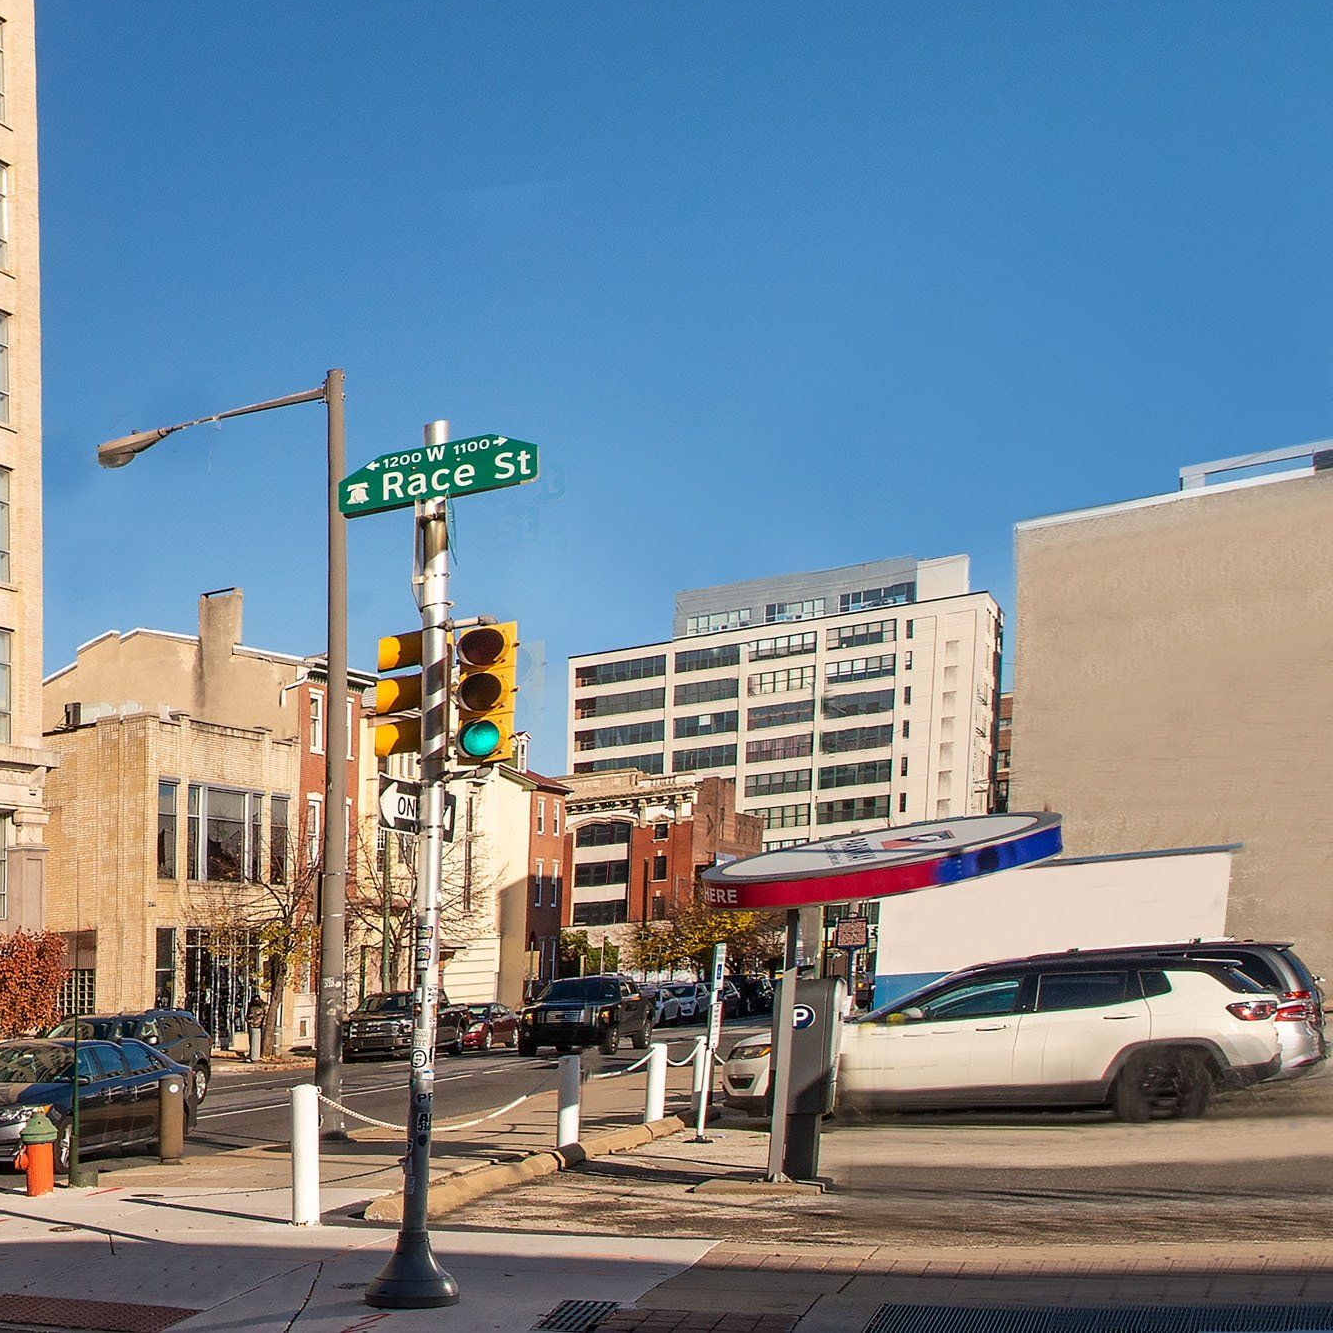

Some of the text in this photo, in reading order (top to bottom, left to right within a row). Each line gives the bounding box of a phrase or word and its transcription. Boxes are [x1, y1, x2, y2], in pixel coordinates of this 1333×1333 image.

[383, 438, 490, 469] 1200 W 1100
[382, 450, 532, 501] Race St
[397, 796, 416, 818] ON
[704, 886, 739, 904] HERE
[792, 1008, 809, 1027] P
